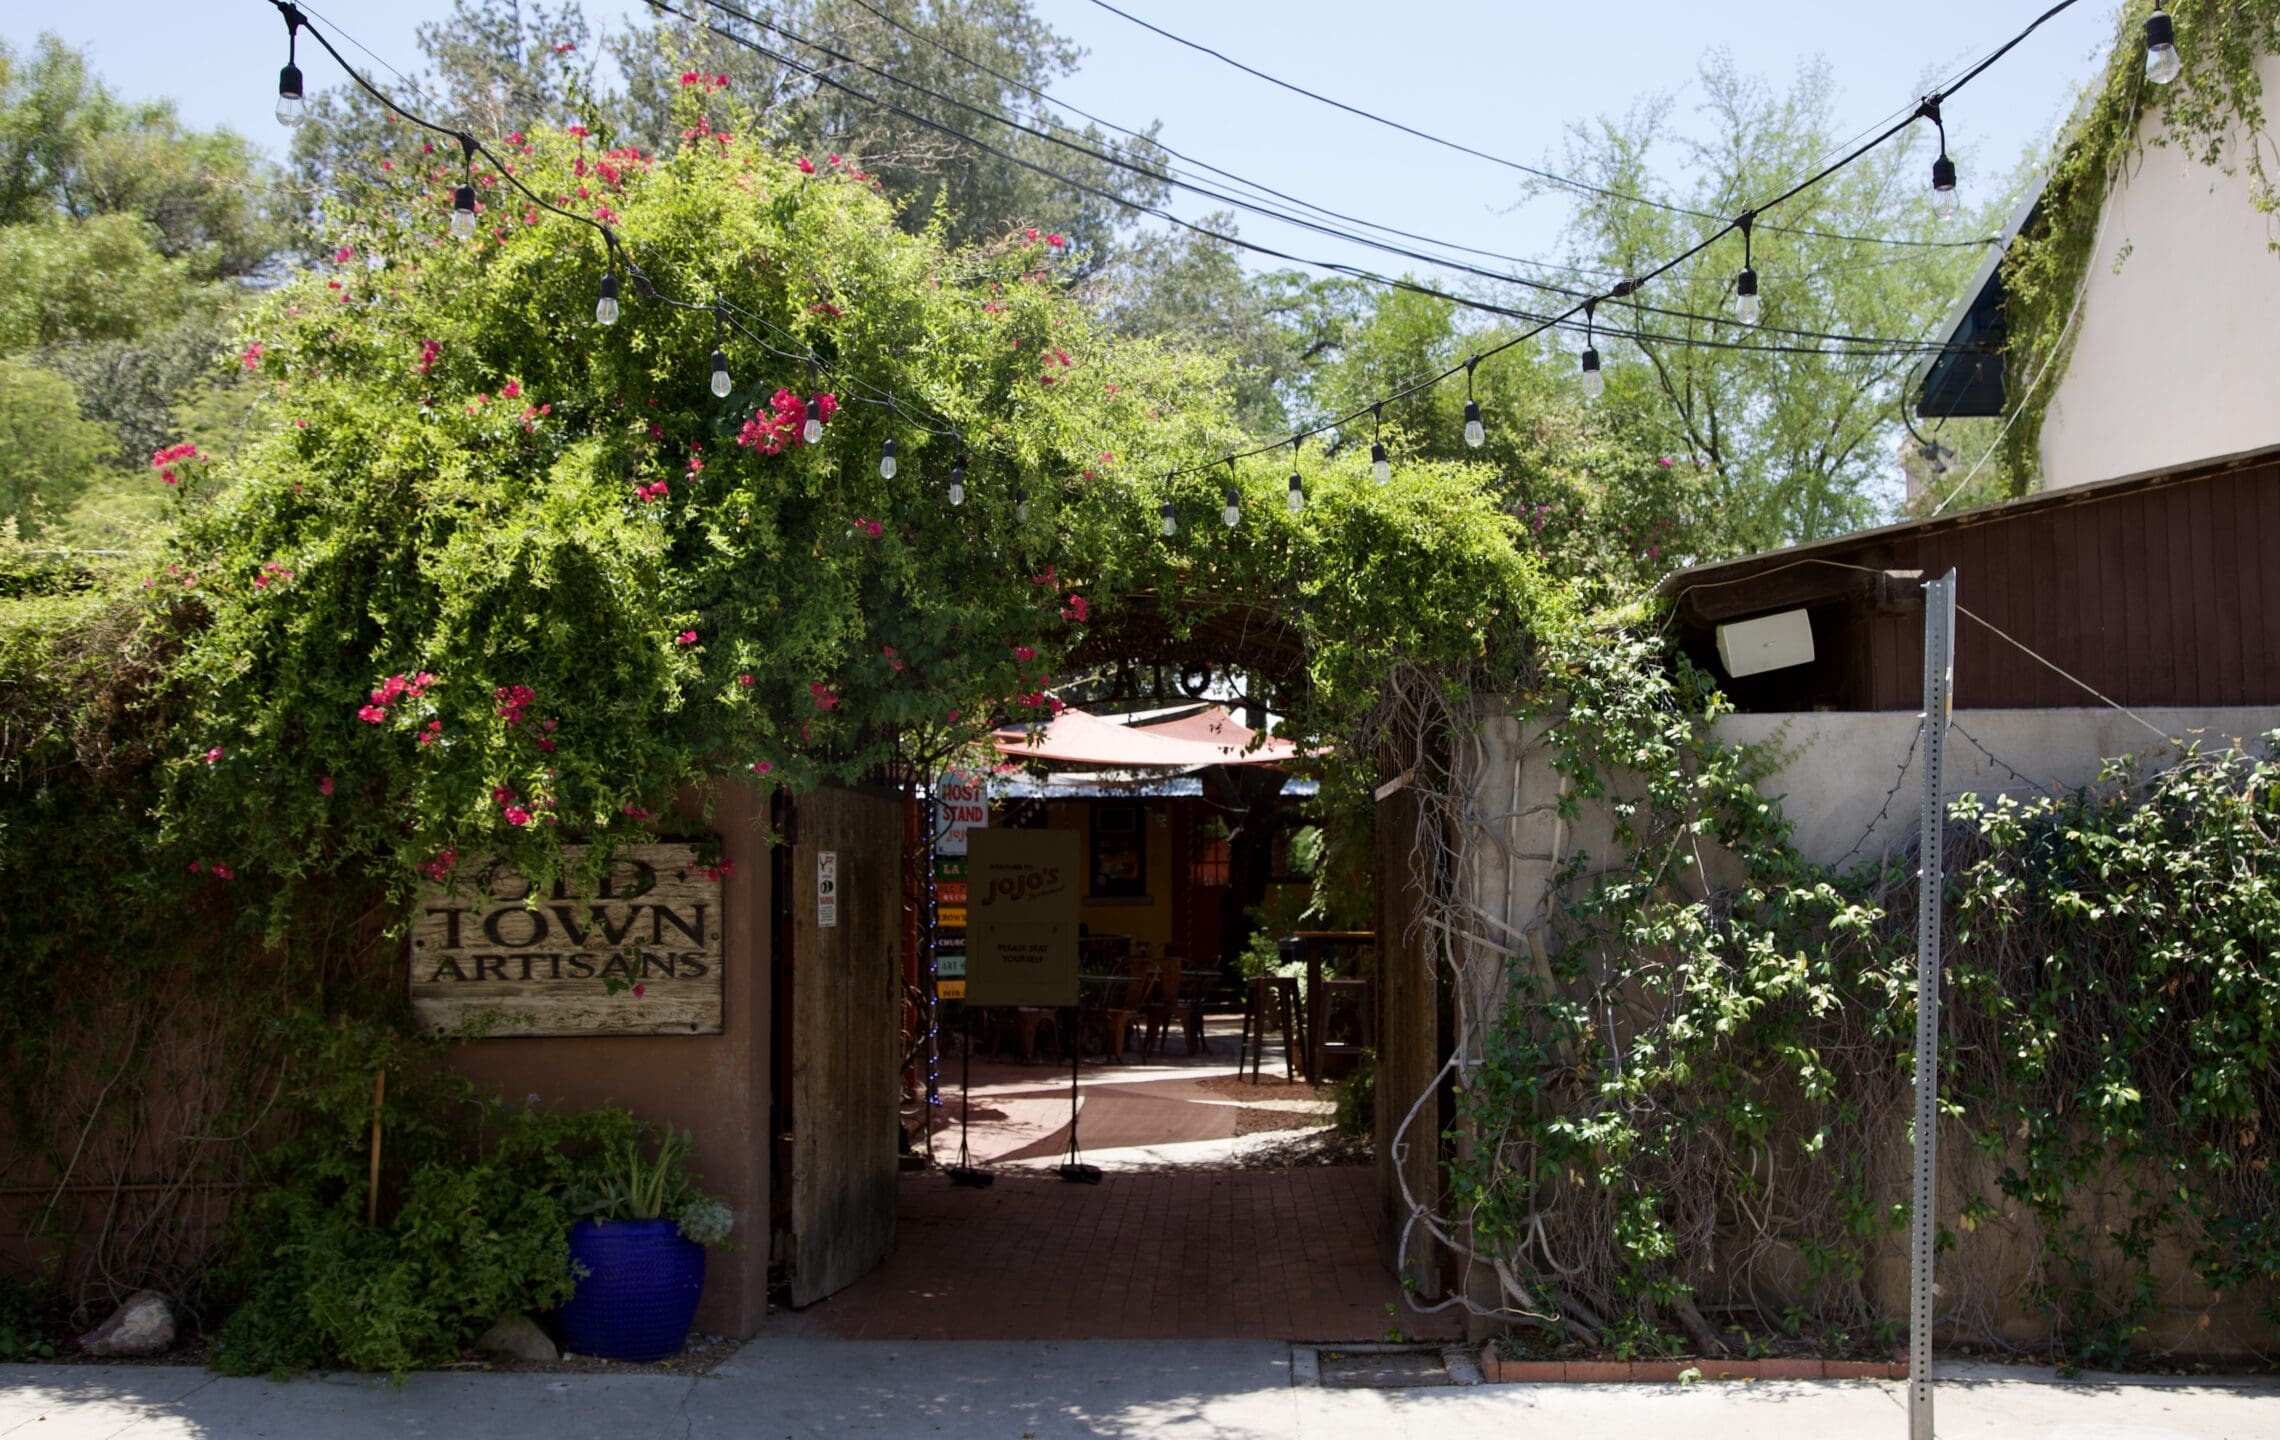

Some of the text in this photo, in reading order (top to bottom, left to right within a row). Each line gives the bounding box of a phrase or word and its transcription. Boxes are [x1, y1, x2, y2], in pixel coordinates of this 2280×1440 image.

[941, 784, 980, 802] HOST
[943, 806, 984, 823] STAND
[943, 864, 961, 875] LA
[981, 865, 1060, 906] JOJO'S
[427, 904, 710, 949] TOWN
[427, 952, 710, 982] ARTISANS
